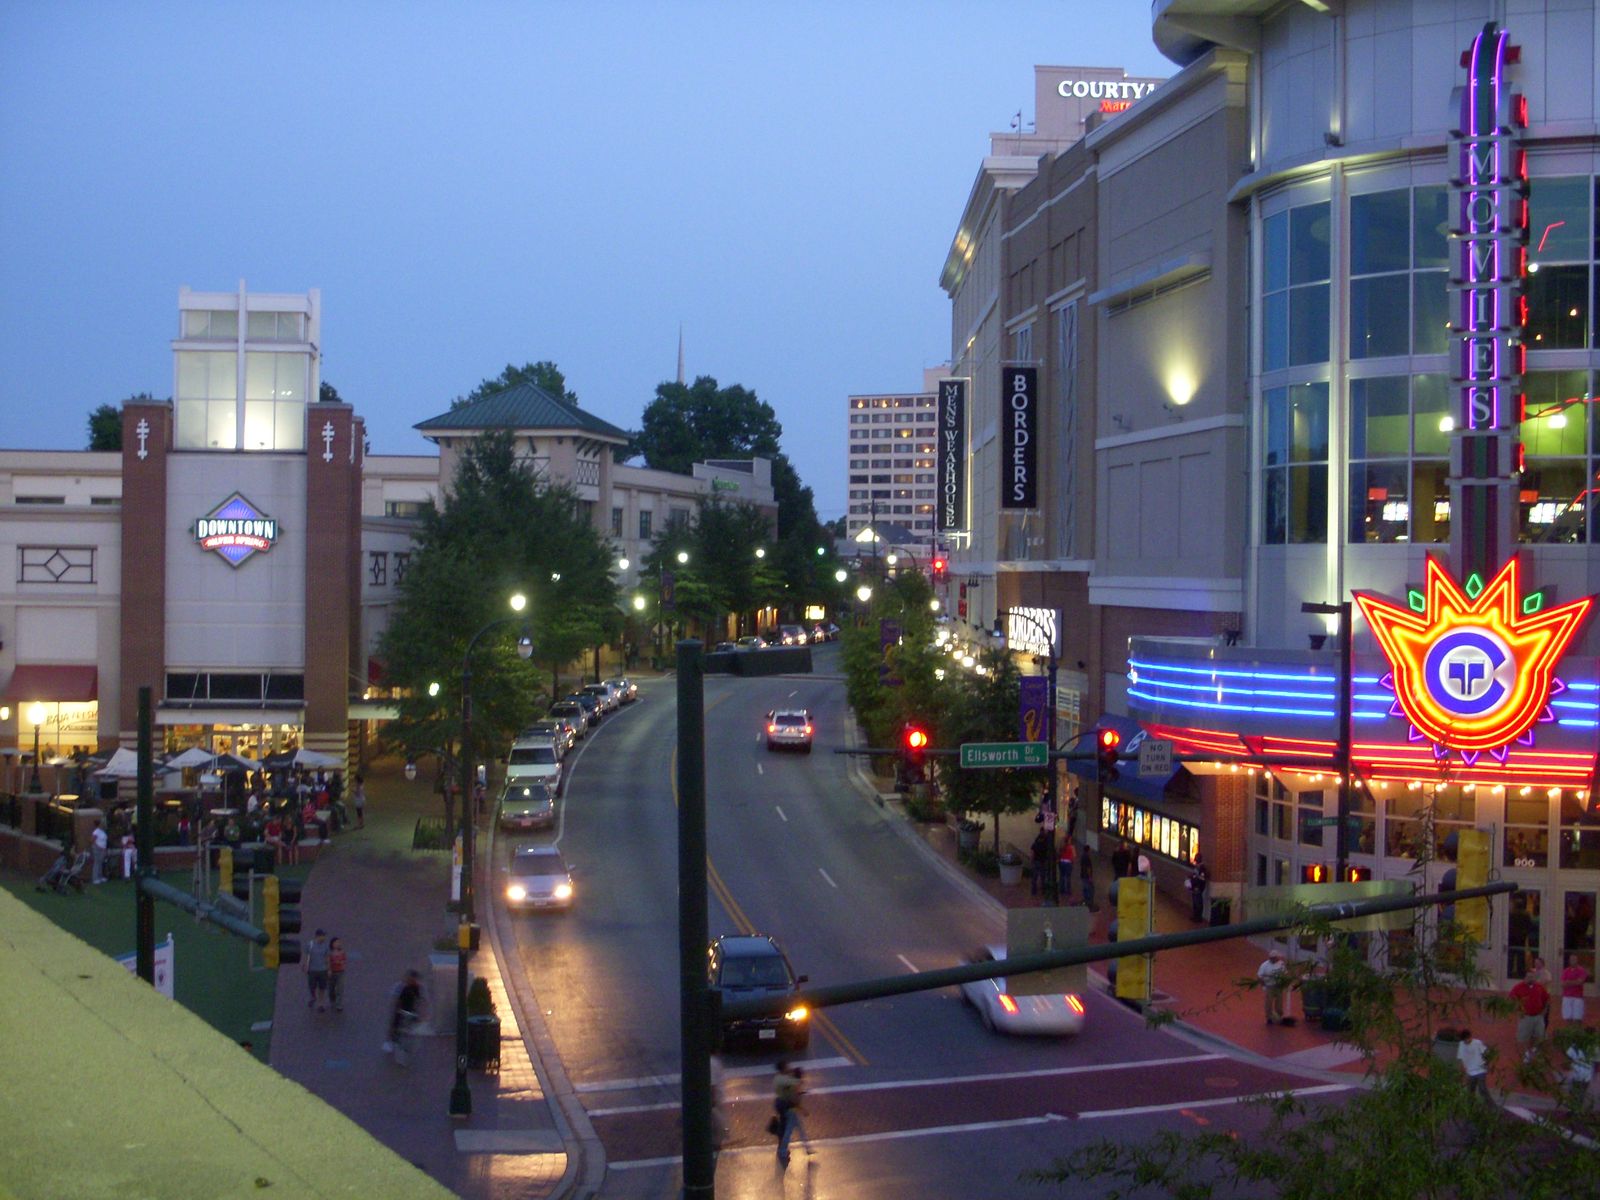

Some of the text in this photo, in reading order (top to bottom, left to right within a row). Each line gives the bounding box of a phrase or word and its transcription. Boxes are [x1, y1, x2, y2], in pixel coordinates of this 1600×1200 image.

[1466, 147, 1497, 422] MOVIES
[1012, 374, 1029, 501] BORDERS
[944, 430, 958, 527] WEARHOUSE
[198, 519, 274, 539] DOWNTOWN
[967, 746, 1034, 762] Ellsworth Dr
[1146, 753, 1166, 761] TURN
[1150, 744, 1163, 752] NO
[1141, 764, 1152, 772] ON
